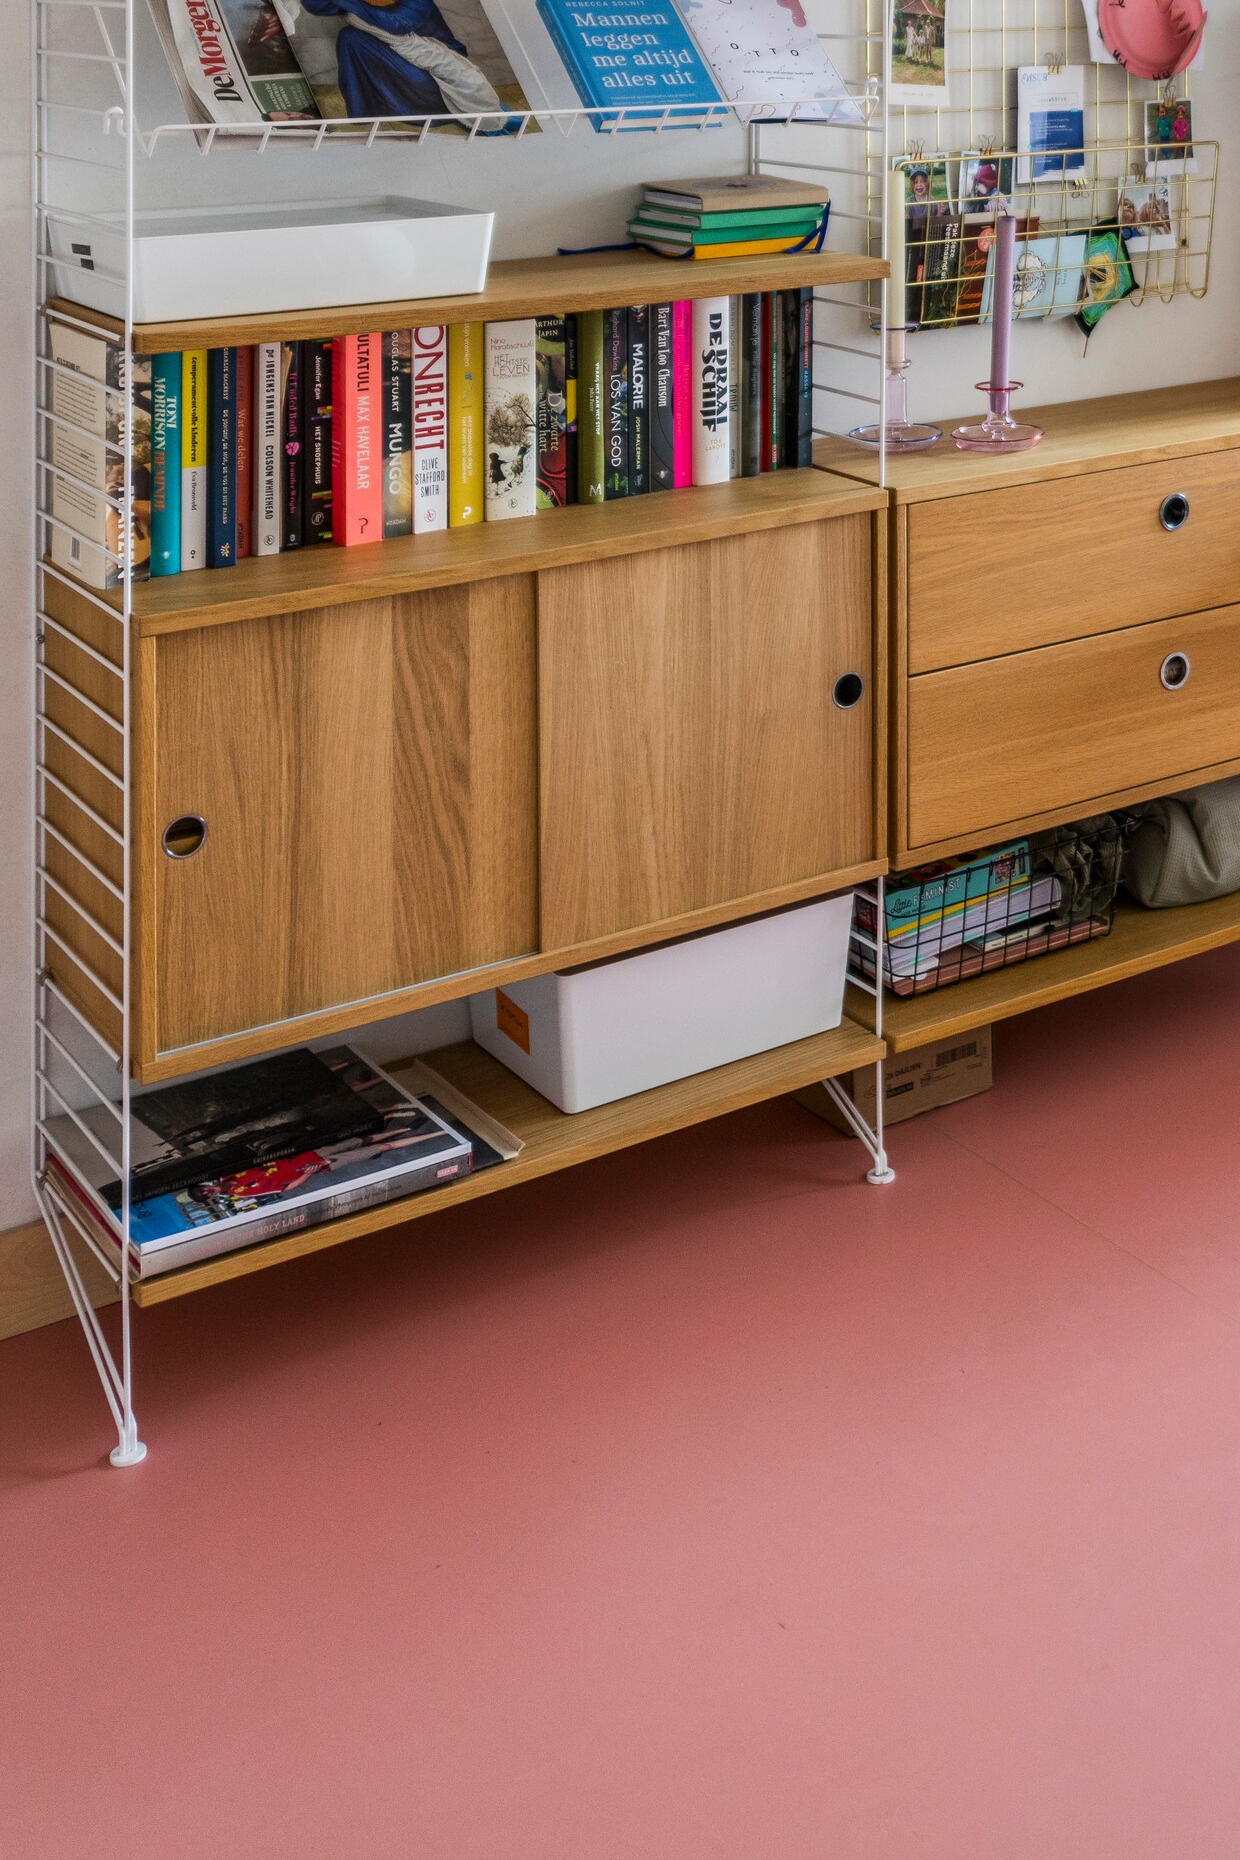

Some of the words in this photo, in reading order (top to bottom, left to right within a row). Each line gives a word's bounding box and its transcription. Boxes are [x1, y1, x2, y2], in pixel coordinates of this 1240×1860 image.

[571, 13, 668, 27] Mannen
[581, 32, 659, 49] leggen
[593, 55, 626, 66] me
[633, 49, 693, 68] altijd
[602, 73, 656, 87] alles
[661, 71, 695, 85] uit
[658, 308, 669, 328] Bart
[710, 313, 722, 346] DE
[658, 330, 669, 347] Van
[357, 334, 368, 391] ULTATULI
[612, 340, 620, 371] Dawkins
[658, 349, 669, 365] Loo
[190, 357, 198, 425] temperamentvolle
[265, 360, 274, 393] JONGENS
[413, 326, 444, 450] ONRECHT
[610, 374, 620, 398] LOS
[632, 344, 643, 410] MALORIE
[658, 369, 670, 407] Chanson
[700, 349, 716, 432] SCHIJF
[717, 349, 727, 424] DRAAI
[154, 376, 166, 451] MORRISON
[166, 396, 177, 429] TONI
[265, 395, 274, 409] VAN
[357, 396, 368, 422] MAX
[539, 400, 547, 427] witte
[548, 390, 563, 413] De
[265, 412, 274, 437] NICKEL
[611, 402, 620, 431] VAN
[539, 430, 548, 452] hart
[550, 416, 559, 451] zwarte
[265, 445, 273, 476] COLSON
[357, 426, 369, 489] HAVELAAR
[388, 423, 401, 494] MUNGO
[422, 457, 438, 470] CLIVE
[611, 435, 621, 467] GOD
[415, 471, 445, 485] STAFFORD
[421, 485, 439, 497] SMITH
[265, 479, 273, 520] WHITEHEAD
[257, 1223, 279, 1236] HOLY
[282, 1214, 305, 1228] LAND
